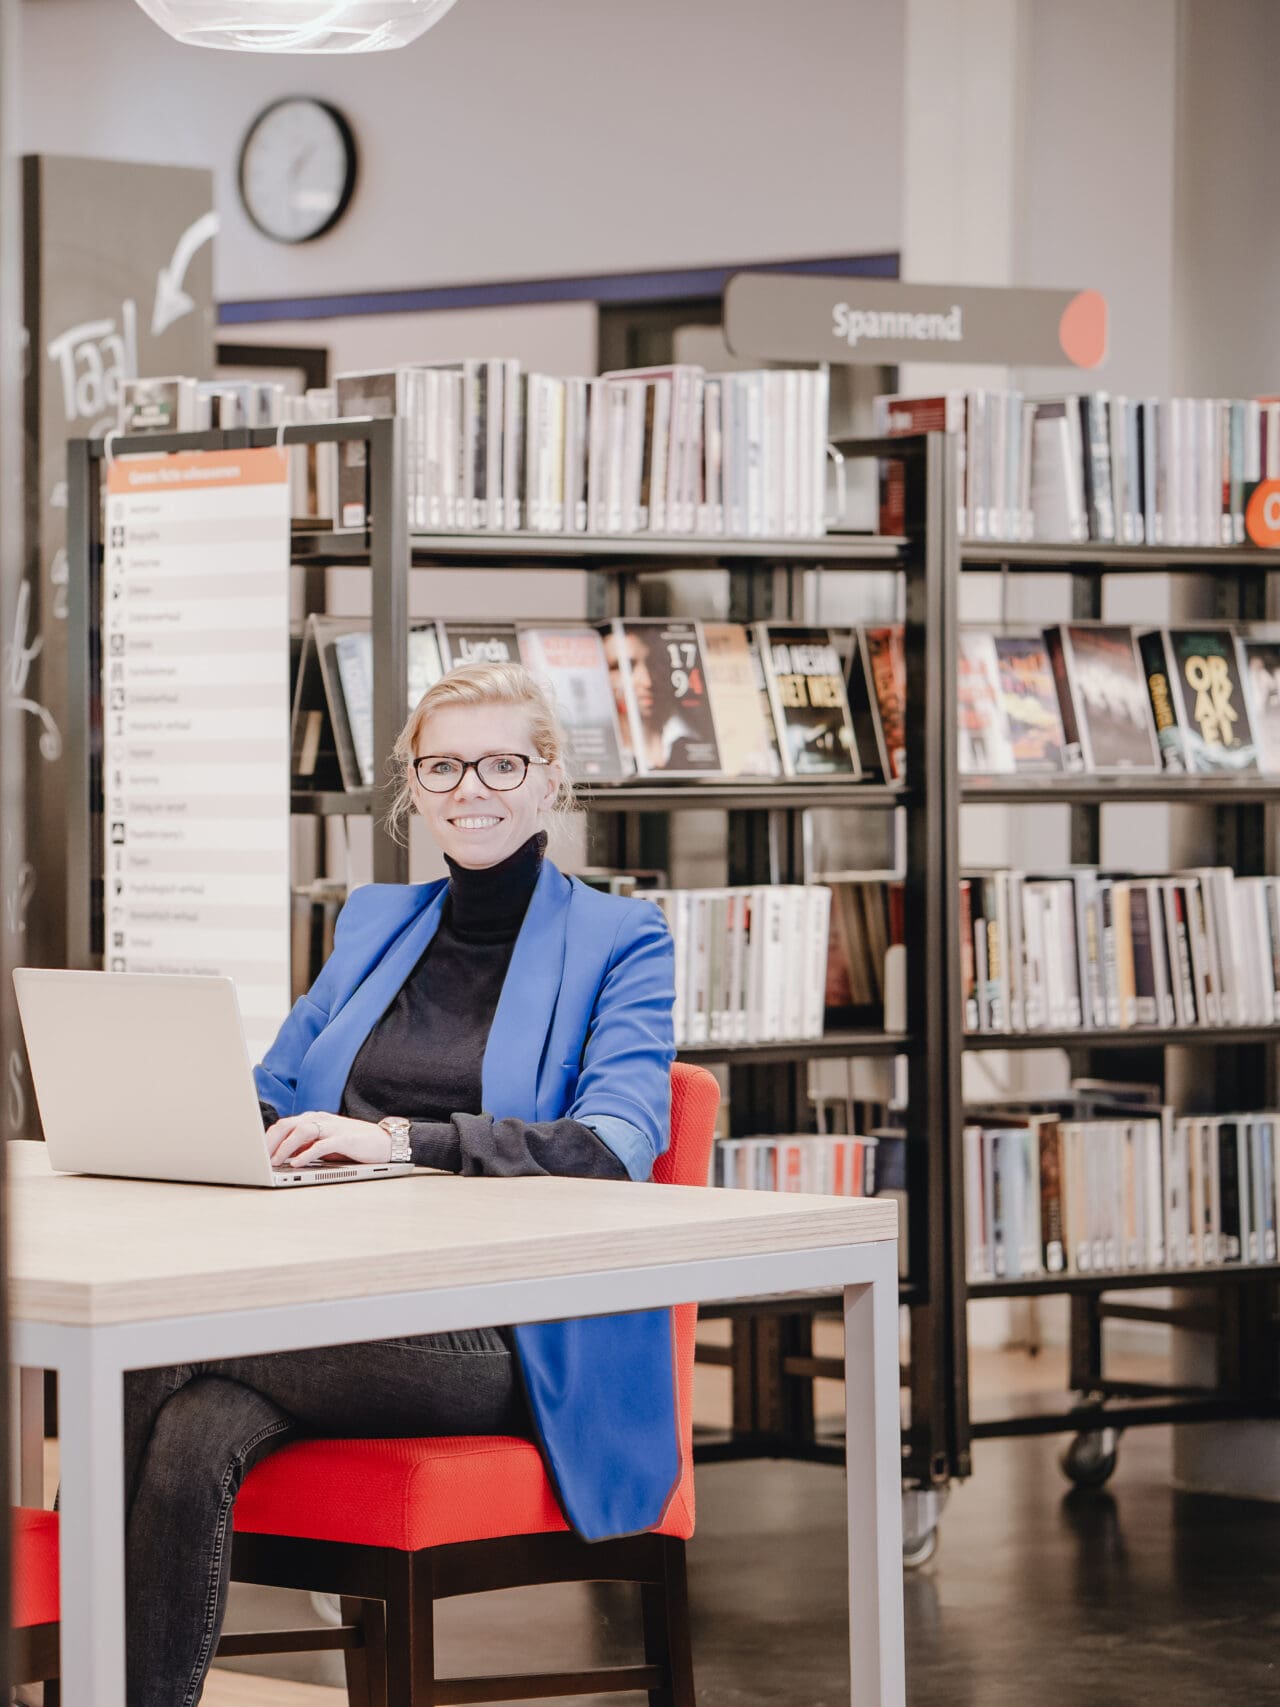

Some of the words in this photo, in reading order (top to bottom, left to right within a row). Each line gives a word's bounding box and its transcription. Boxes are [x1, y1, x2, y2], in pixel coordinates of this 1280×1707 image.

[831, 302, 964, 346] Spannend
[47, 299, 138, 420] Taal
[666, 643, 697, 669] 17
